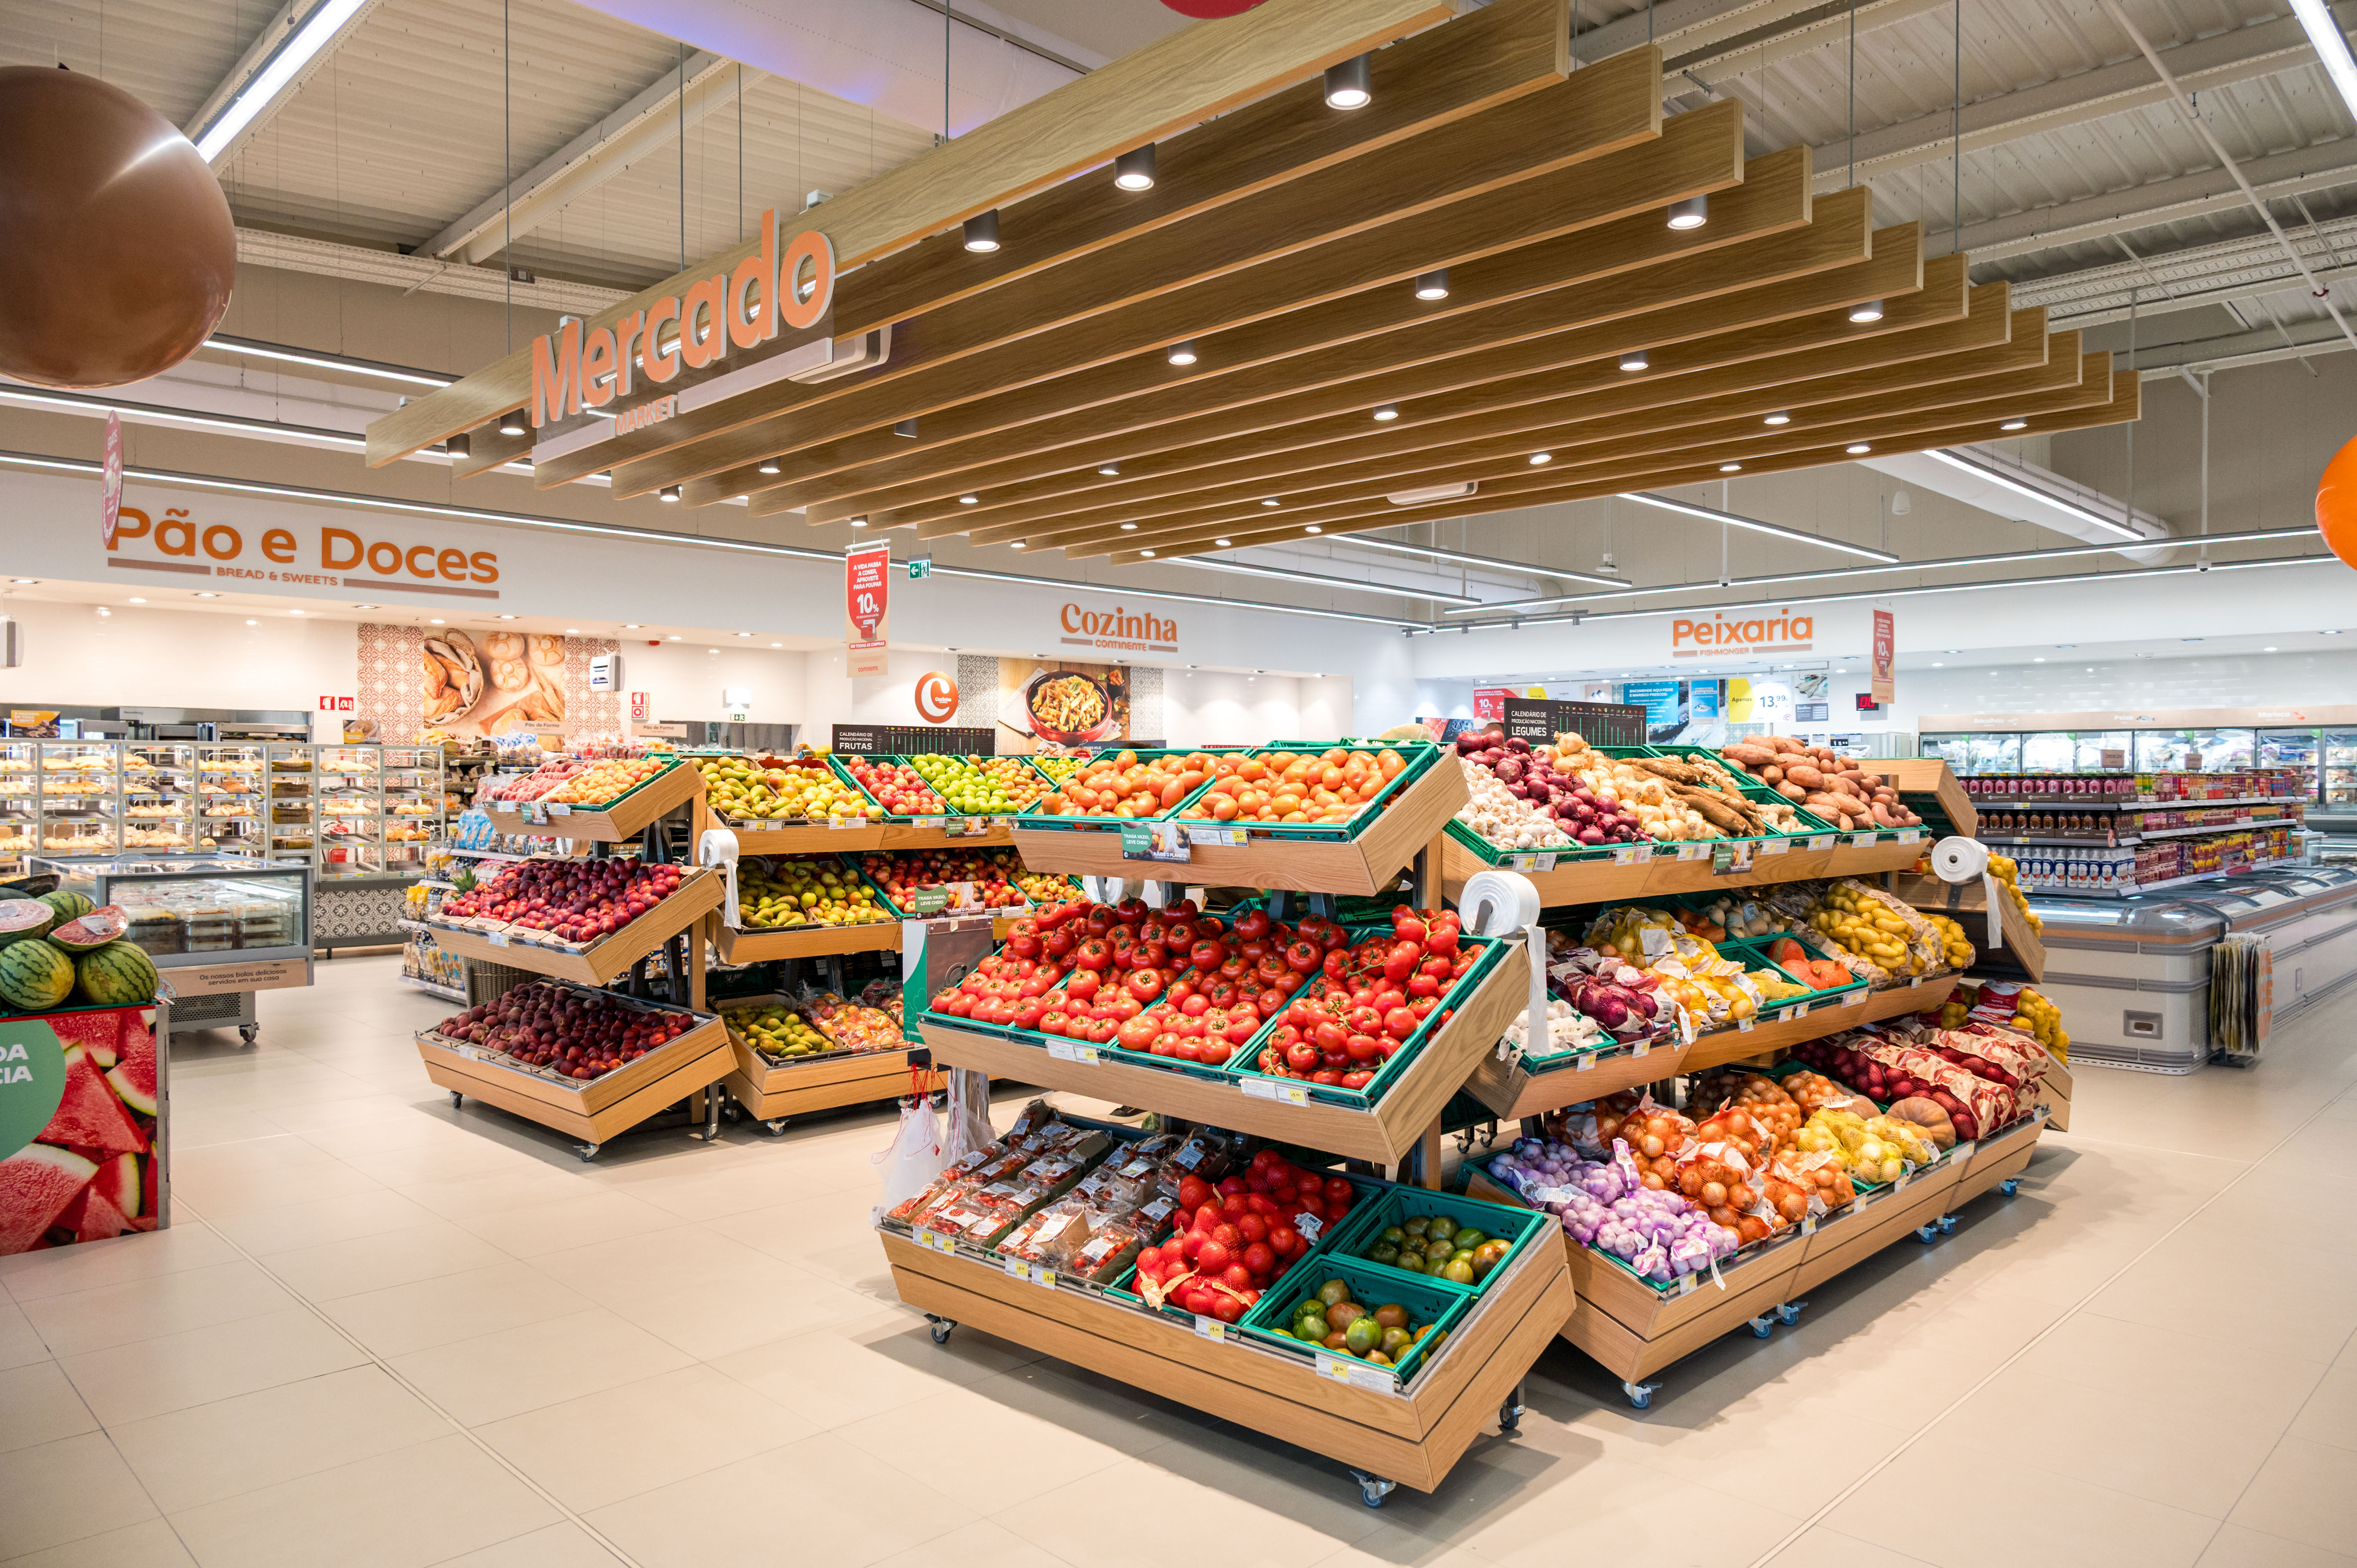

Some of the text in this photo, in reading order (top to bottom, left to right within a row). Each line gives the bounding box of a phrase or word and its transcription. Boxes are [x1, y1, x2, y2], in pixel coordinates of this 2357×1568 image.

[532, 208, 836, 428] Mercado
[616, 394, 678, 435] MARKET
[107, 506, 500, 583] Pão e Doces
[216, 566, 338, 586] BREAD & SWEETS
[857, 575, 879, 583] APROVEITE
[857, 593, 879, 614] 10%
[1060, 603, 1178, 642] Cozinha
[1673, 608, 1813, 646] Peixaria
[1095, 639, 1147, 651] CONTINENTE
[1700, 647, 1749, 656] FISHMONGER
[1877, 641, 1889, 657] 10%
[1479, 698, 1493, 708] 10%
[1512, 726, 1547, 736] LEGUMES
[0, 1065, 34, 1084] IA
